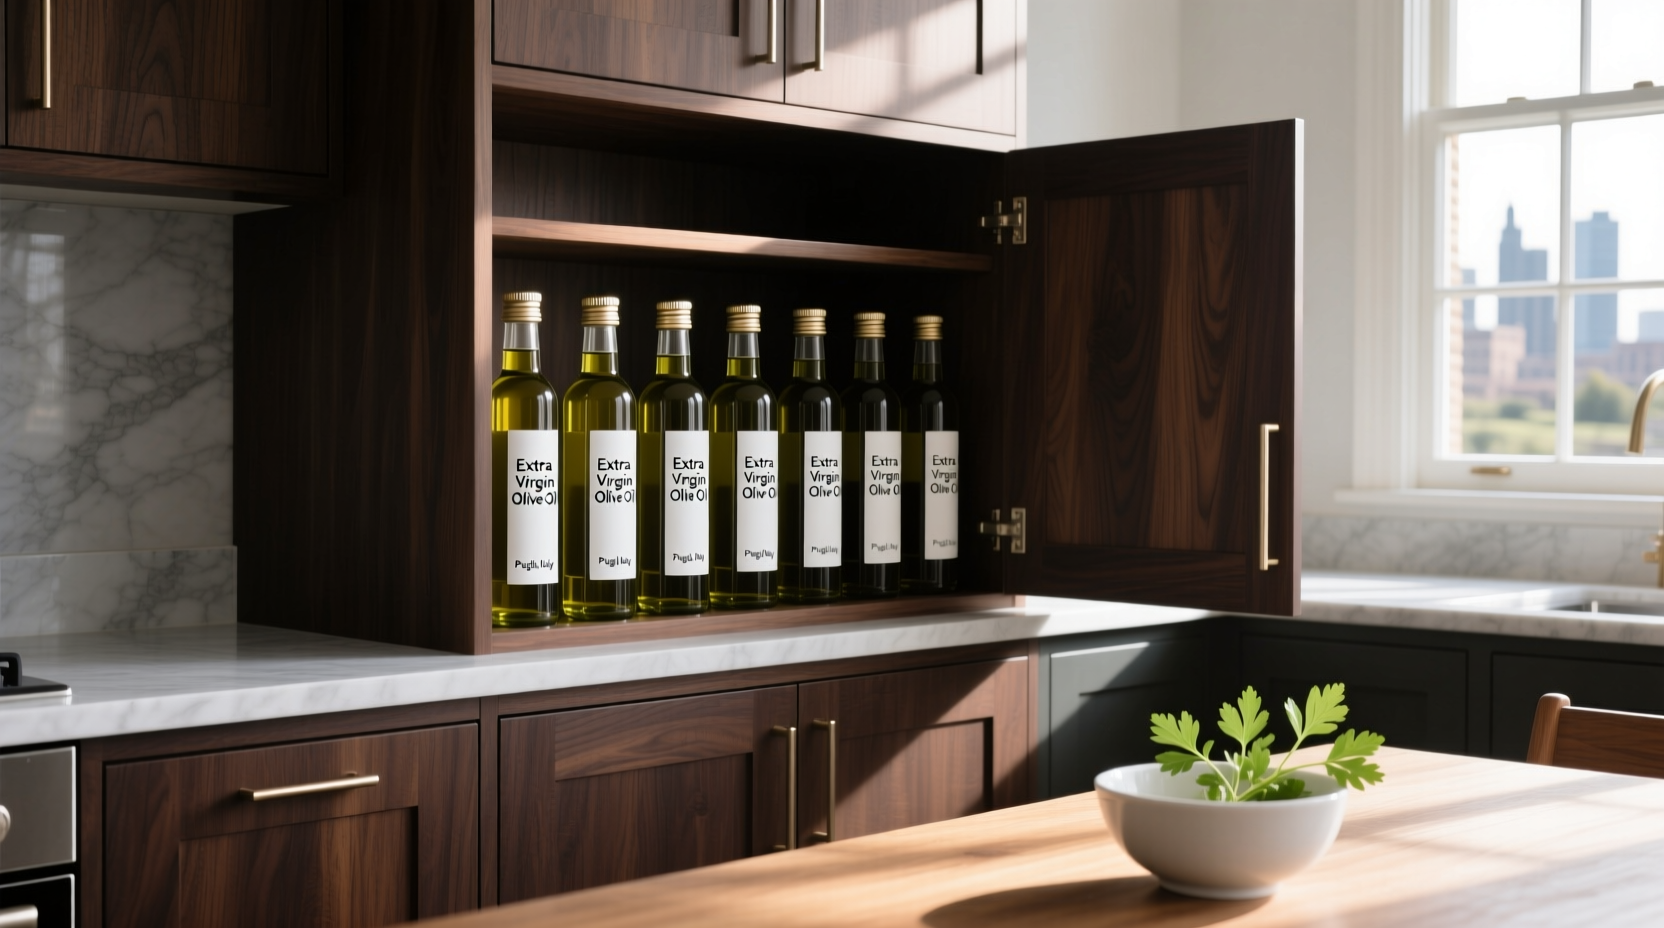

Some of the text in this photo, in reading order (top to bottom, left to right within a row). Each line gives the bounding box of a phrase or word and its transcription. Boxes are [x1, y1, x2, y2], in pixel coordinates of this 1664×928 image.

[517, 458, 553, 472] Extra
[597, 458, 631, 471] Extra
[673, 457, 704, 470] Extra
[745, 456, 774, 468] Extra
[811, 455, 838, 467] Extra
[872, 455, 898, 467] Extra
[932, 455, 956, 466] Extra
[515, 475, 555, 492] Virgin
[596, 473, 633, 490] Virgin
[744, 471, 776, 486] Virgin
[810, 470, 840, 485] Virgin
[512, 491, 543, 505] Olive
[594, 489, 622, 503] Olive
